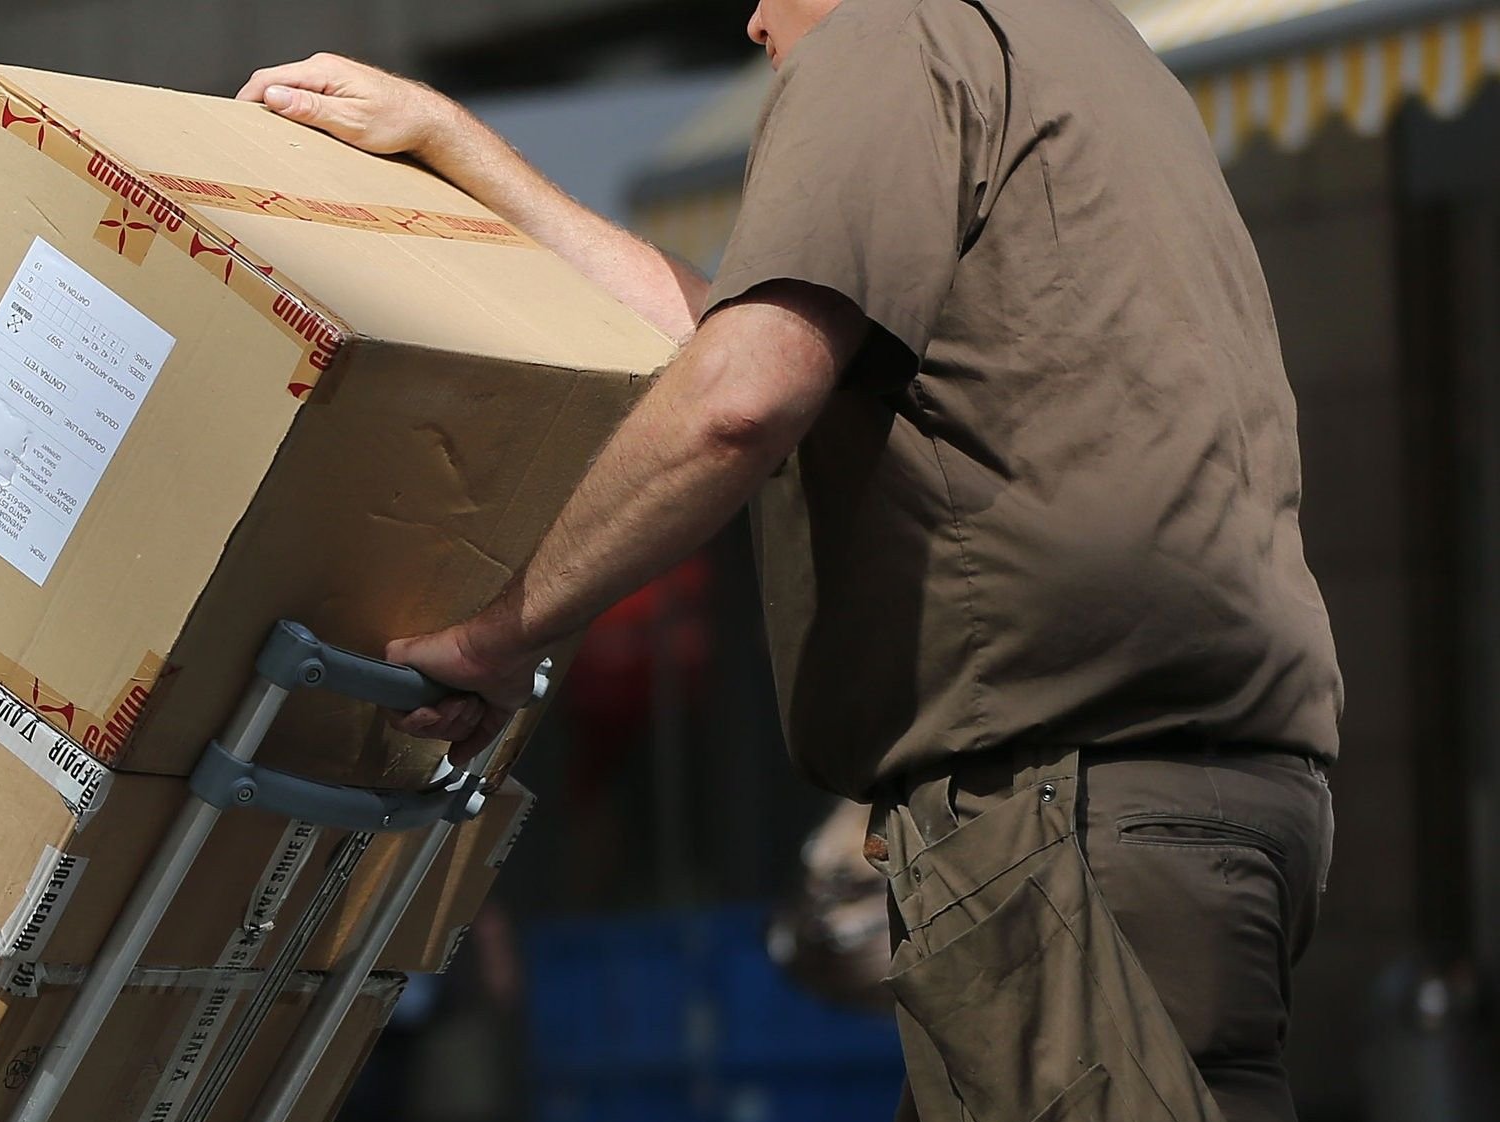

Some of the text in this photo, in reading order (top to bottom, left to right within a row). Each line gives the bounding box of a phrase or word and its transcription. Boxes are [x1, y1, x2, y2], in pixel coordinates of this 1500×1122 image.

[87, 150, 187, 232] GOLDMUD
[33, 261, 90, 307] CARTON 19
[14, 282, 146, 382] SIZES: TOTAL
[46, 331, 136, 400] GOLDMUD ARTICLE 3597
[133, 352, 152, 370] PAIRS:
[8, 377, 106, 453] GOLDMUD LINE: KOLPINO MEN
[23, 356, 119, 430] COLOUR: LONTRA YETI
[6, 492, 32, 515] 4620-615
[8, 505, 28, 523] SANTO
[43, 489, 72, 515] DELIVERY:
[56, 487, 77, 506] 000645
[28, 544, 47, 562] FROM:
[180, 986, 231, 1064] AVE SHOE
